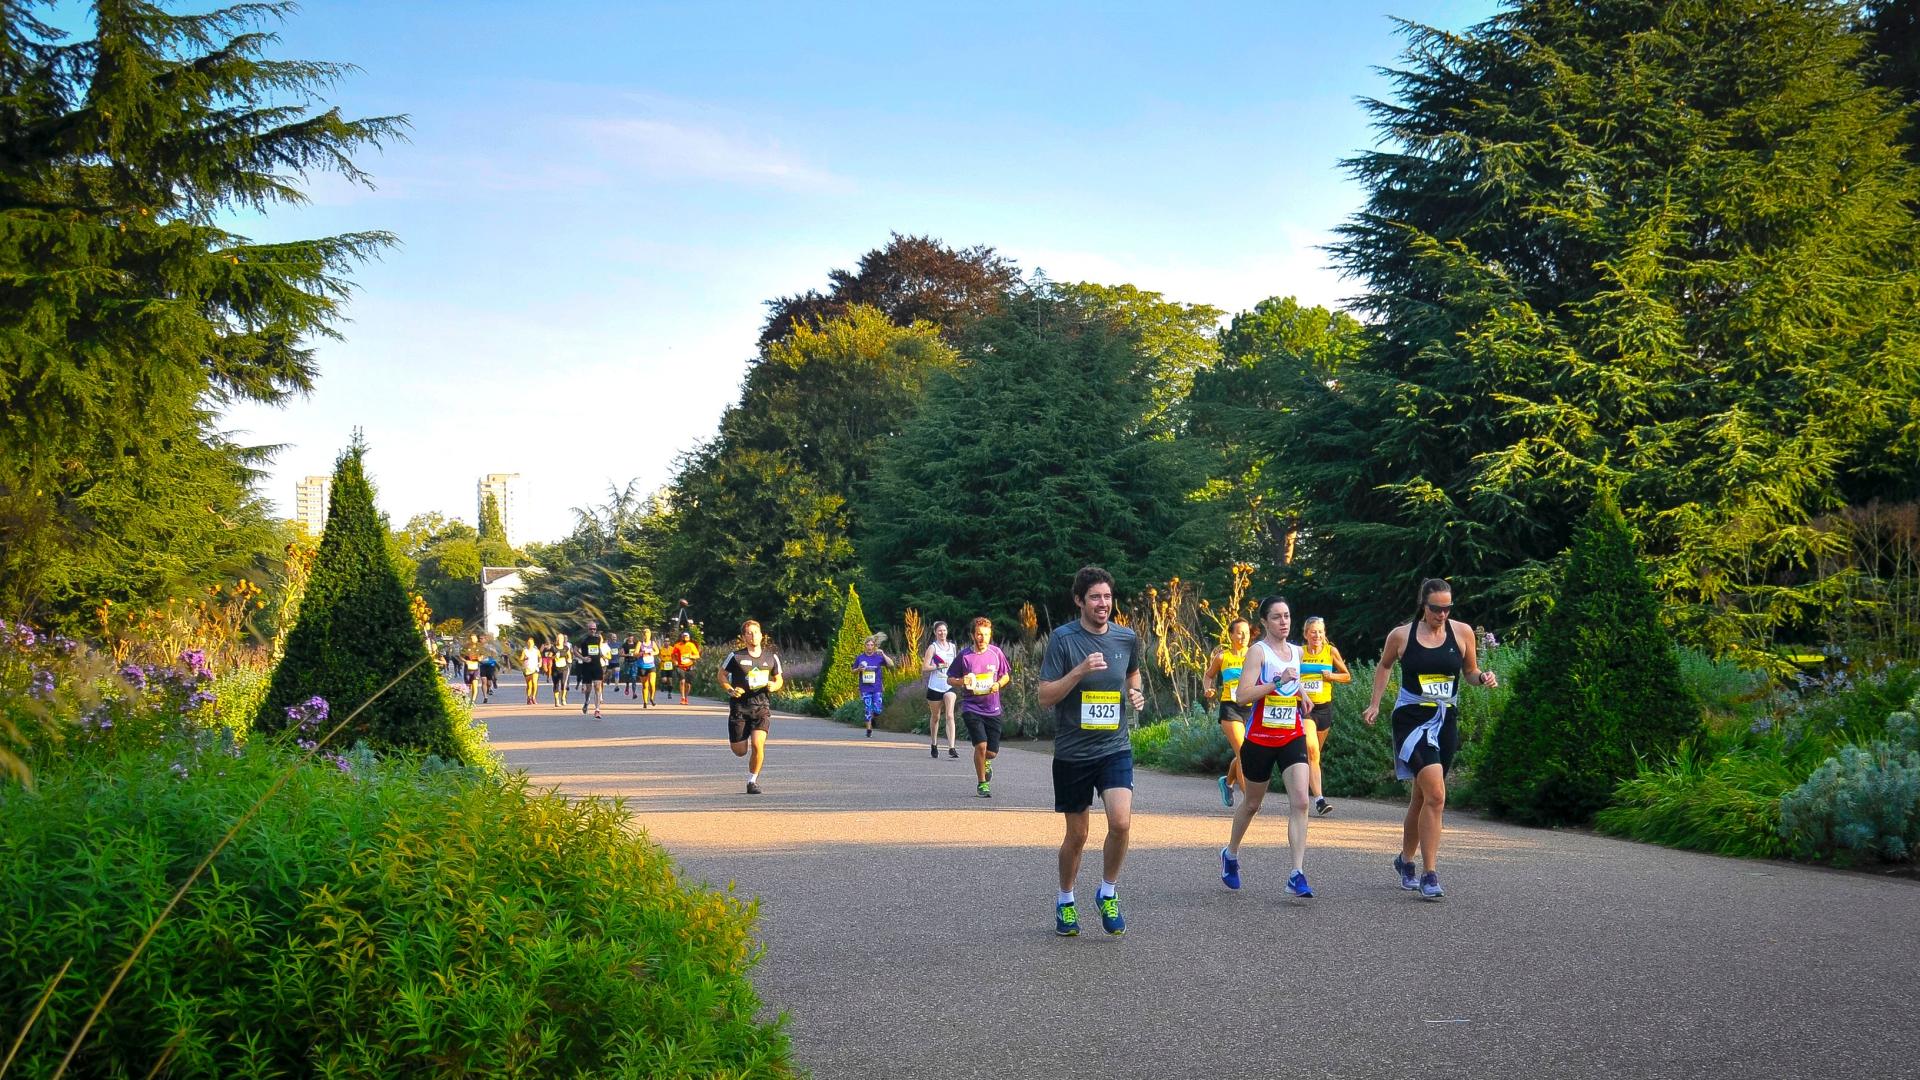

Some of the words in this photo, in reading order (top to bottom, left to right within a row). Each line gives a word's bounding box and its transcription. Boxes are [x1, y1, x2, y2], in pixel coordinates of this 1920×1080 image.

[1304, 681, 1319, 689] 4503
[1428, 682, 1449, 696] 1519
[1088, 704, 1115, 718] 4325
[1269, 707, 1293, 719] 4372
